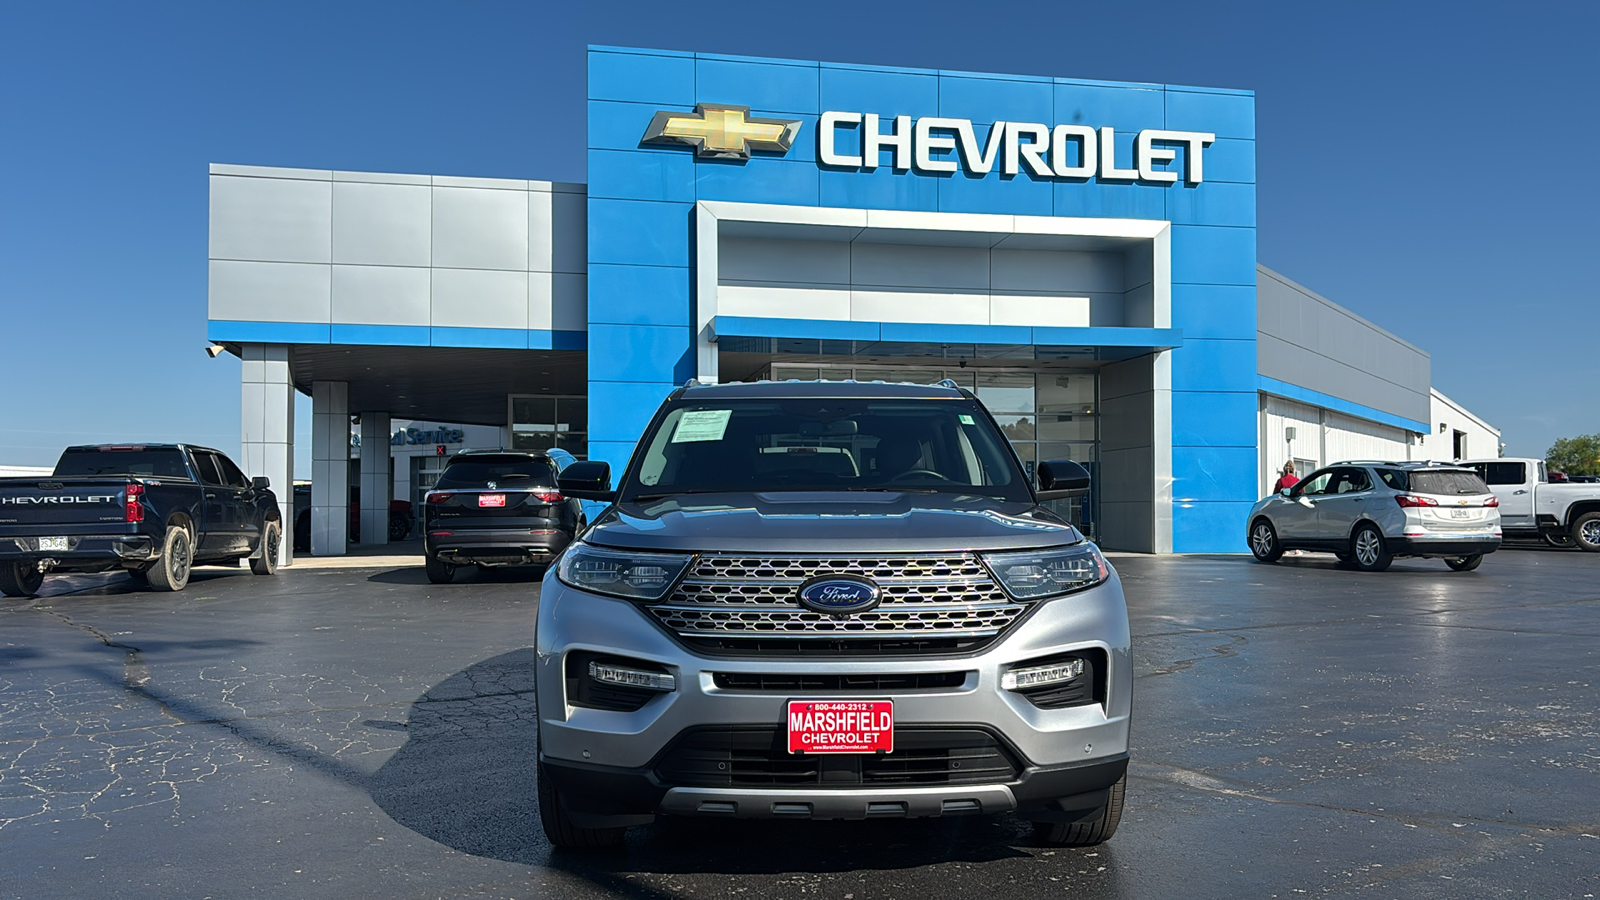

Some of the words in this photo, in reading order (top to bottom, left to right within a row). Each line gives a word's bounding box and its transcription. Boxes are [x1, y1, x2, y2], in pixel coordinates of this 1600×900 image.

[820, 110, 1216, 185] CHEVROLET
[406, 426, 461, 445] Service
[819, 586, 860, 599] Ford
[814, 703, 867, 711] 800-440-2312
[791, 712, 891, 732] MARSHFIELD
[801, 733, 880, 744] CHEVROLET
